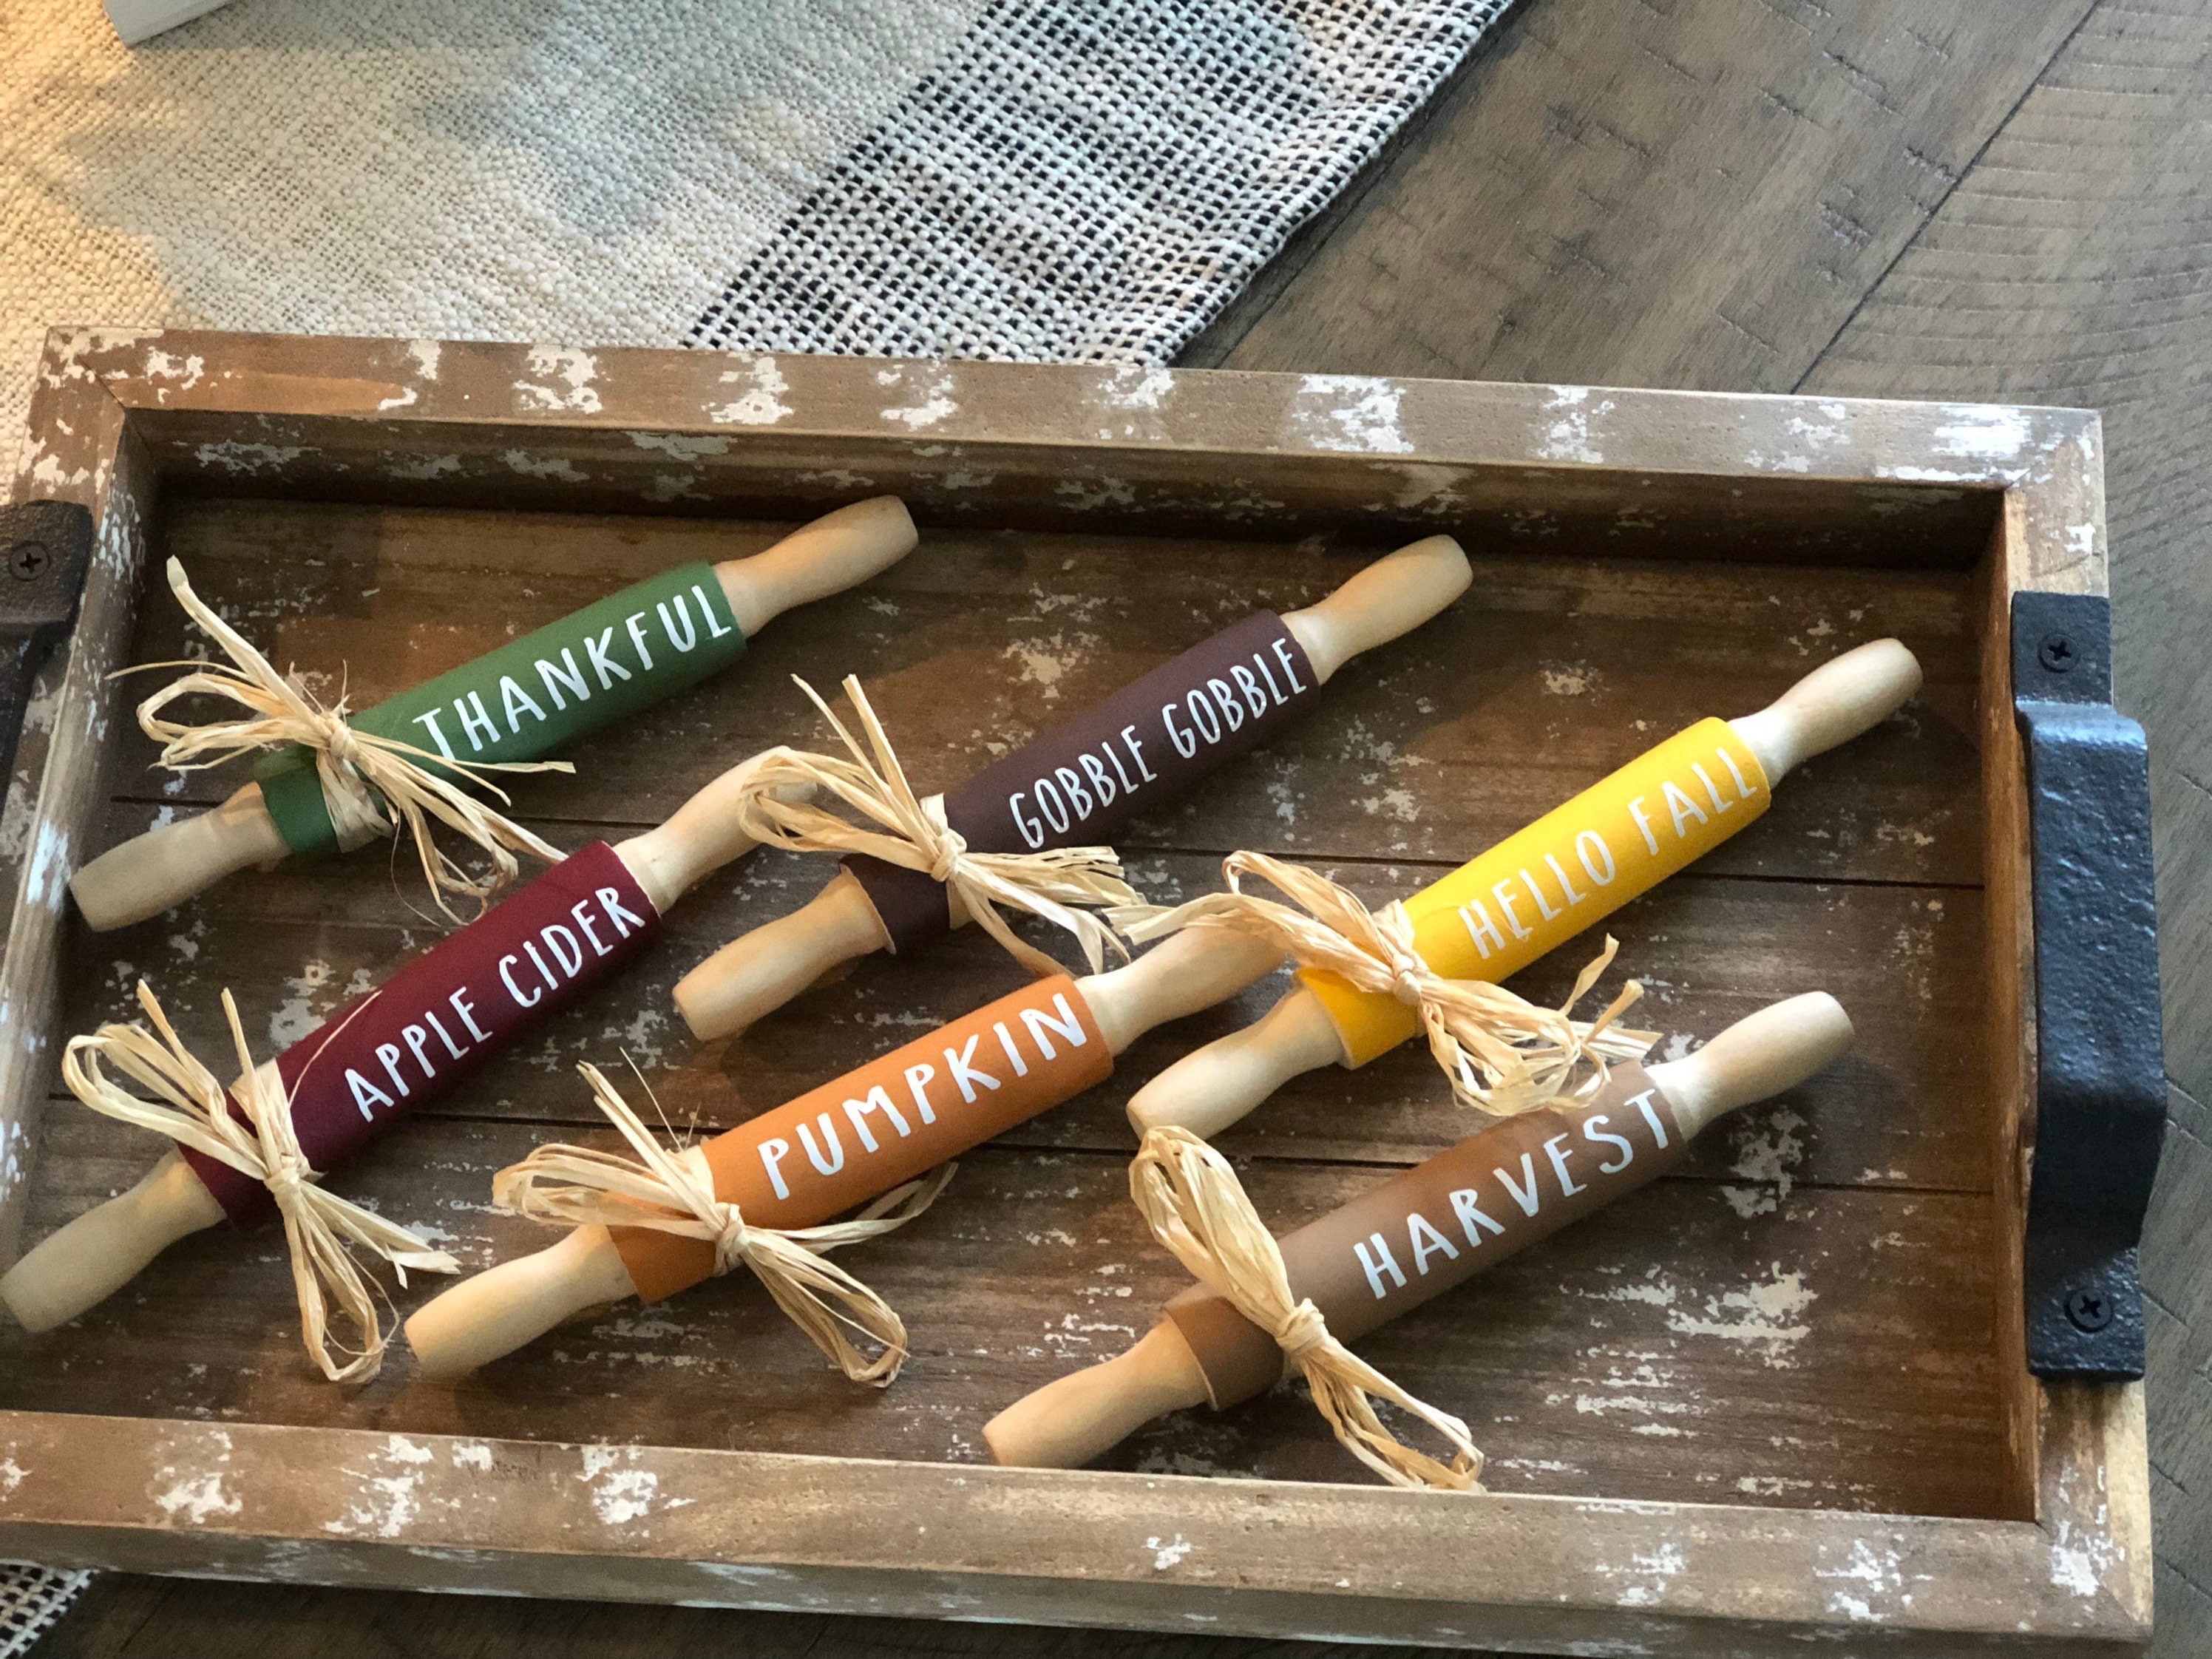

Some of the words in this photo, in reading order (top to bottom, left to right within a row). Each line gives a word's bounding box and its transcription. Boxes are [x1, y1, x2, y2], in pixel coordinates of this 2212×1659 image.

[411, 585, 732, 761] THANKFUL
[1009, 725, 1157, 849] GOBBLE
[1161, 637, 1307, 759] GOBBLE
[1458, 830, 1616, 960] HELLO
[1627, 747, 1757, 855] FALL
[345, 987, 493, 1122] APPLE
[498, 887, 645, 1008] CIDER
[757, 993, 1087, 1200] PUMPKIN
[1353, 1088, 1669, 1298] HARVEST
